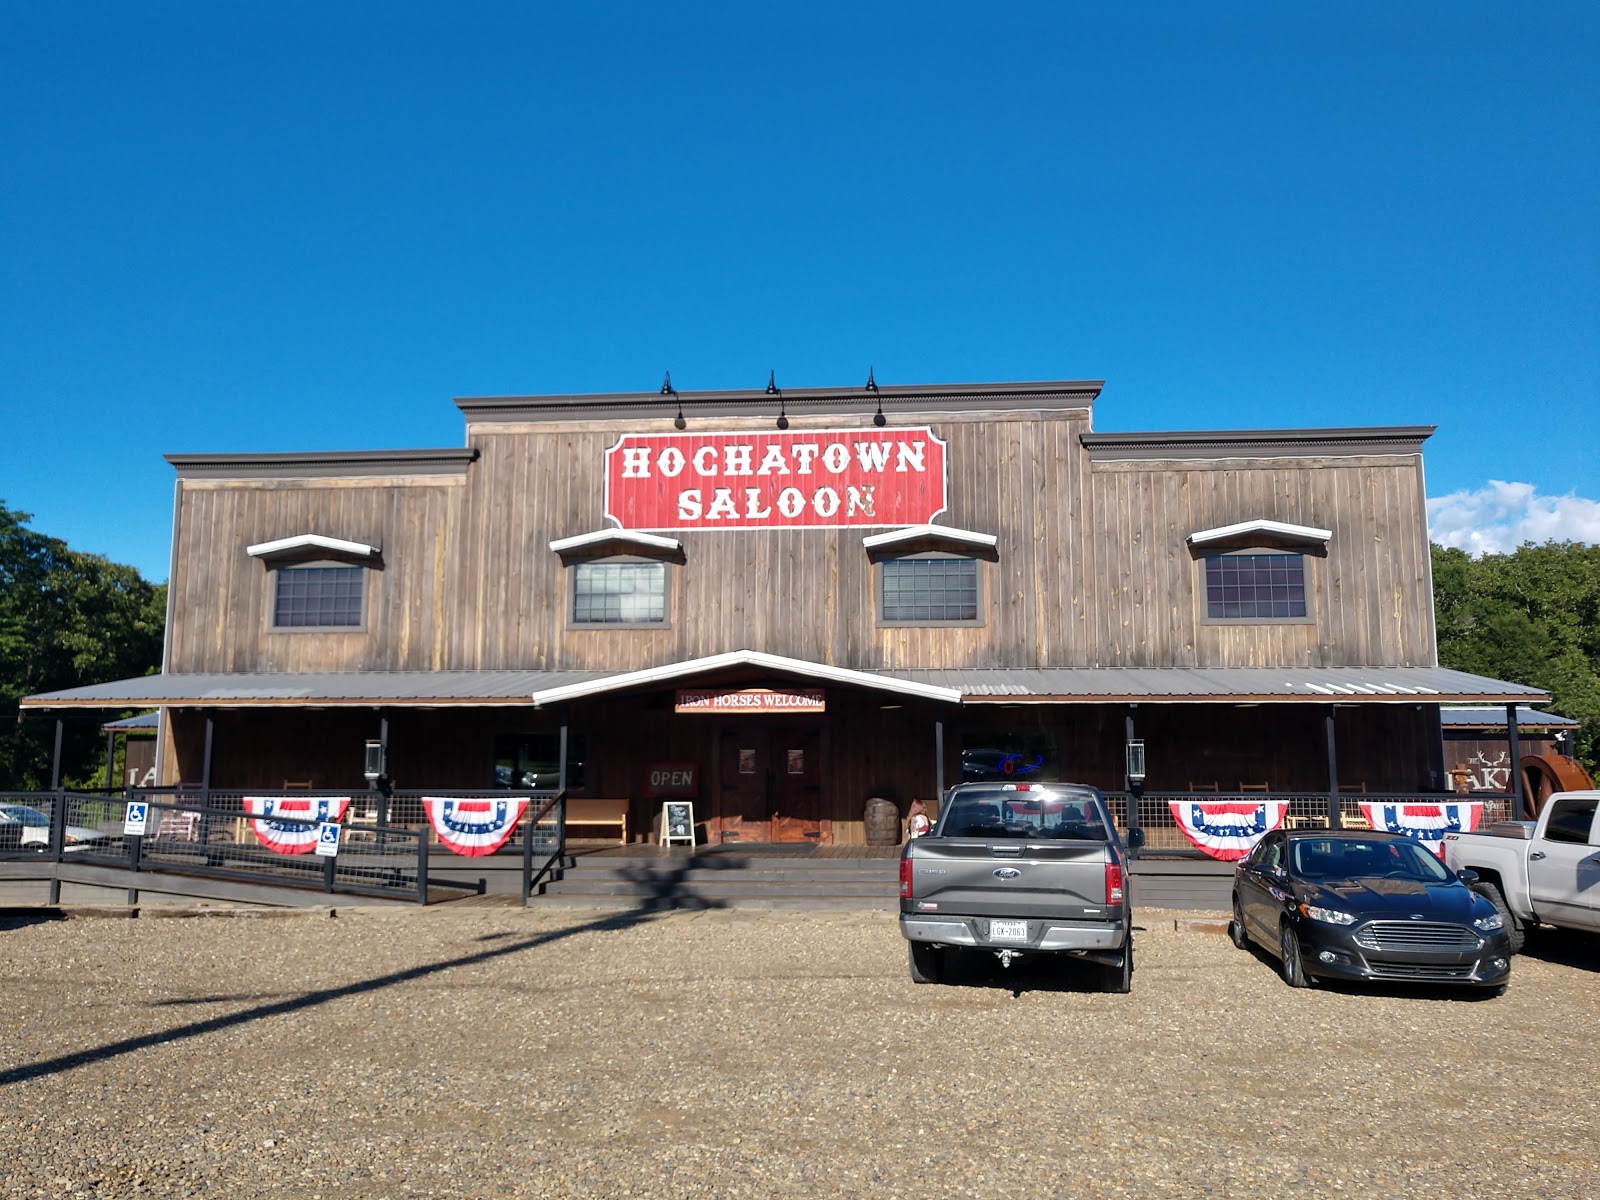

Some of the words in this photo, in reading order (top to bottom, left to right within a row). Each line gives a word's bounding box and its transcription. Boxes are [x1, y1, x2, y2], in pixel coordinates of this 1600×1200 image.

[621, 440, 926, 478] HOCHATOWN
[678, 485, 876, 520] SALOON
[681, 695, 710, 707] IRON
[713, 694, 761, 707] HORSES
[763, 694, 822, 707] WELCOME
[651, 770, 692, 786] OPEN
